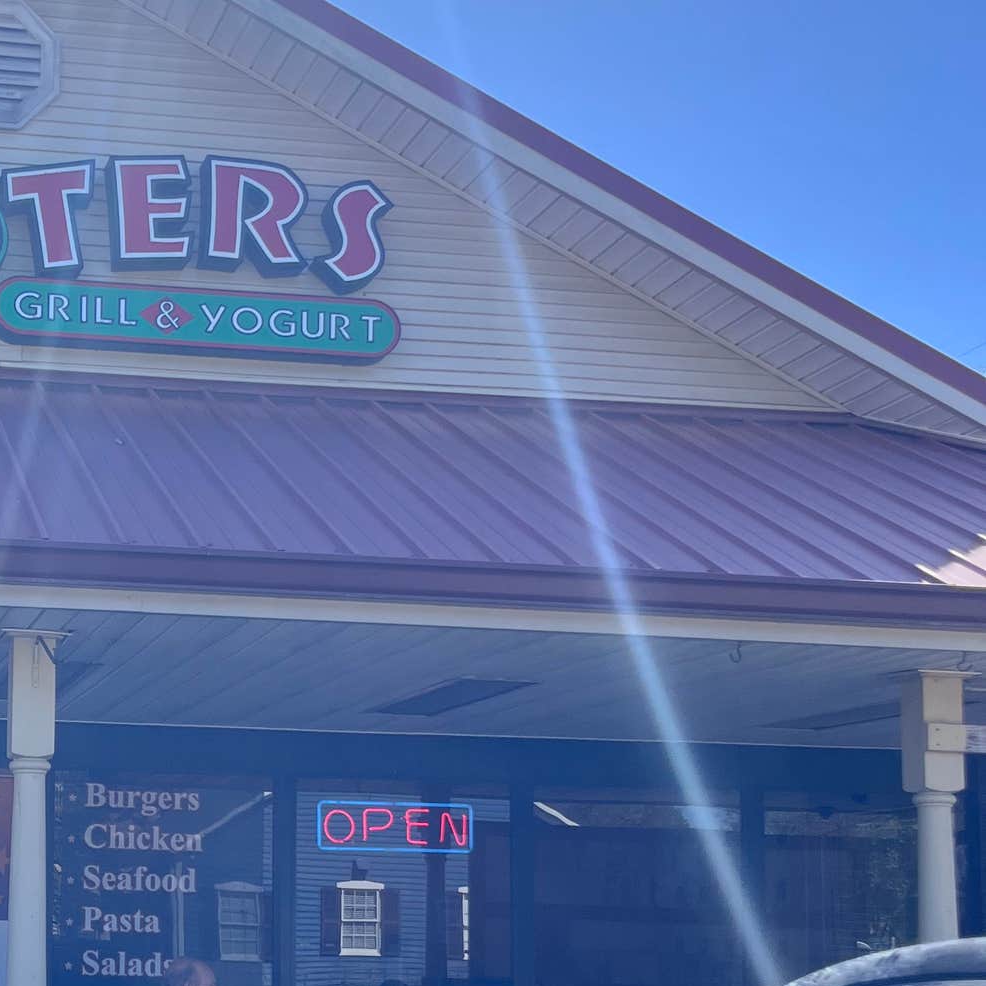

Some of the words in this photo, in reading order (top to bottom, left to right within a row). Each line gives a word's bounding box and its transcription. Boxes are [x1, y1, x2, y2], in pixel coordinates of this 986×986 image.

[14, 291, 136, 326] GRILL
[156, 299, 180, 329] &
[200, 303, 382, 343] YOGURT
[86, 783, 200, 816] Burgers
[84, 823, 203, 852] Chicken
[323, 808, 467, 846] OPEN
[83, 864, 197, 893] Seafood
[81, 906, 161, 933] Pasta
